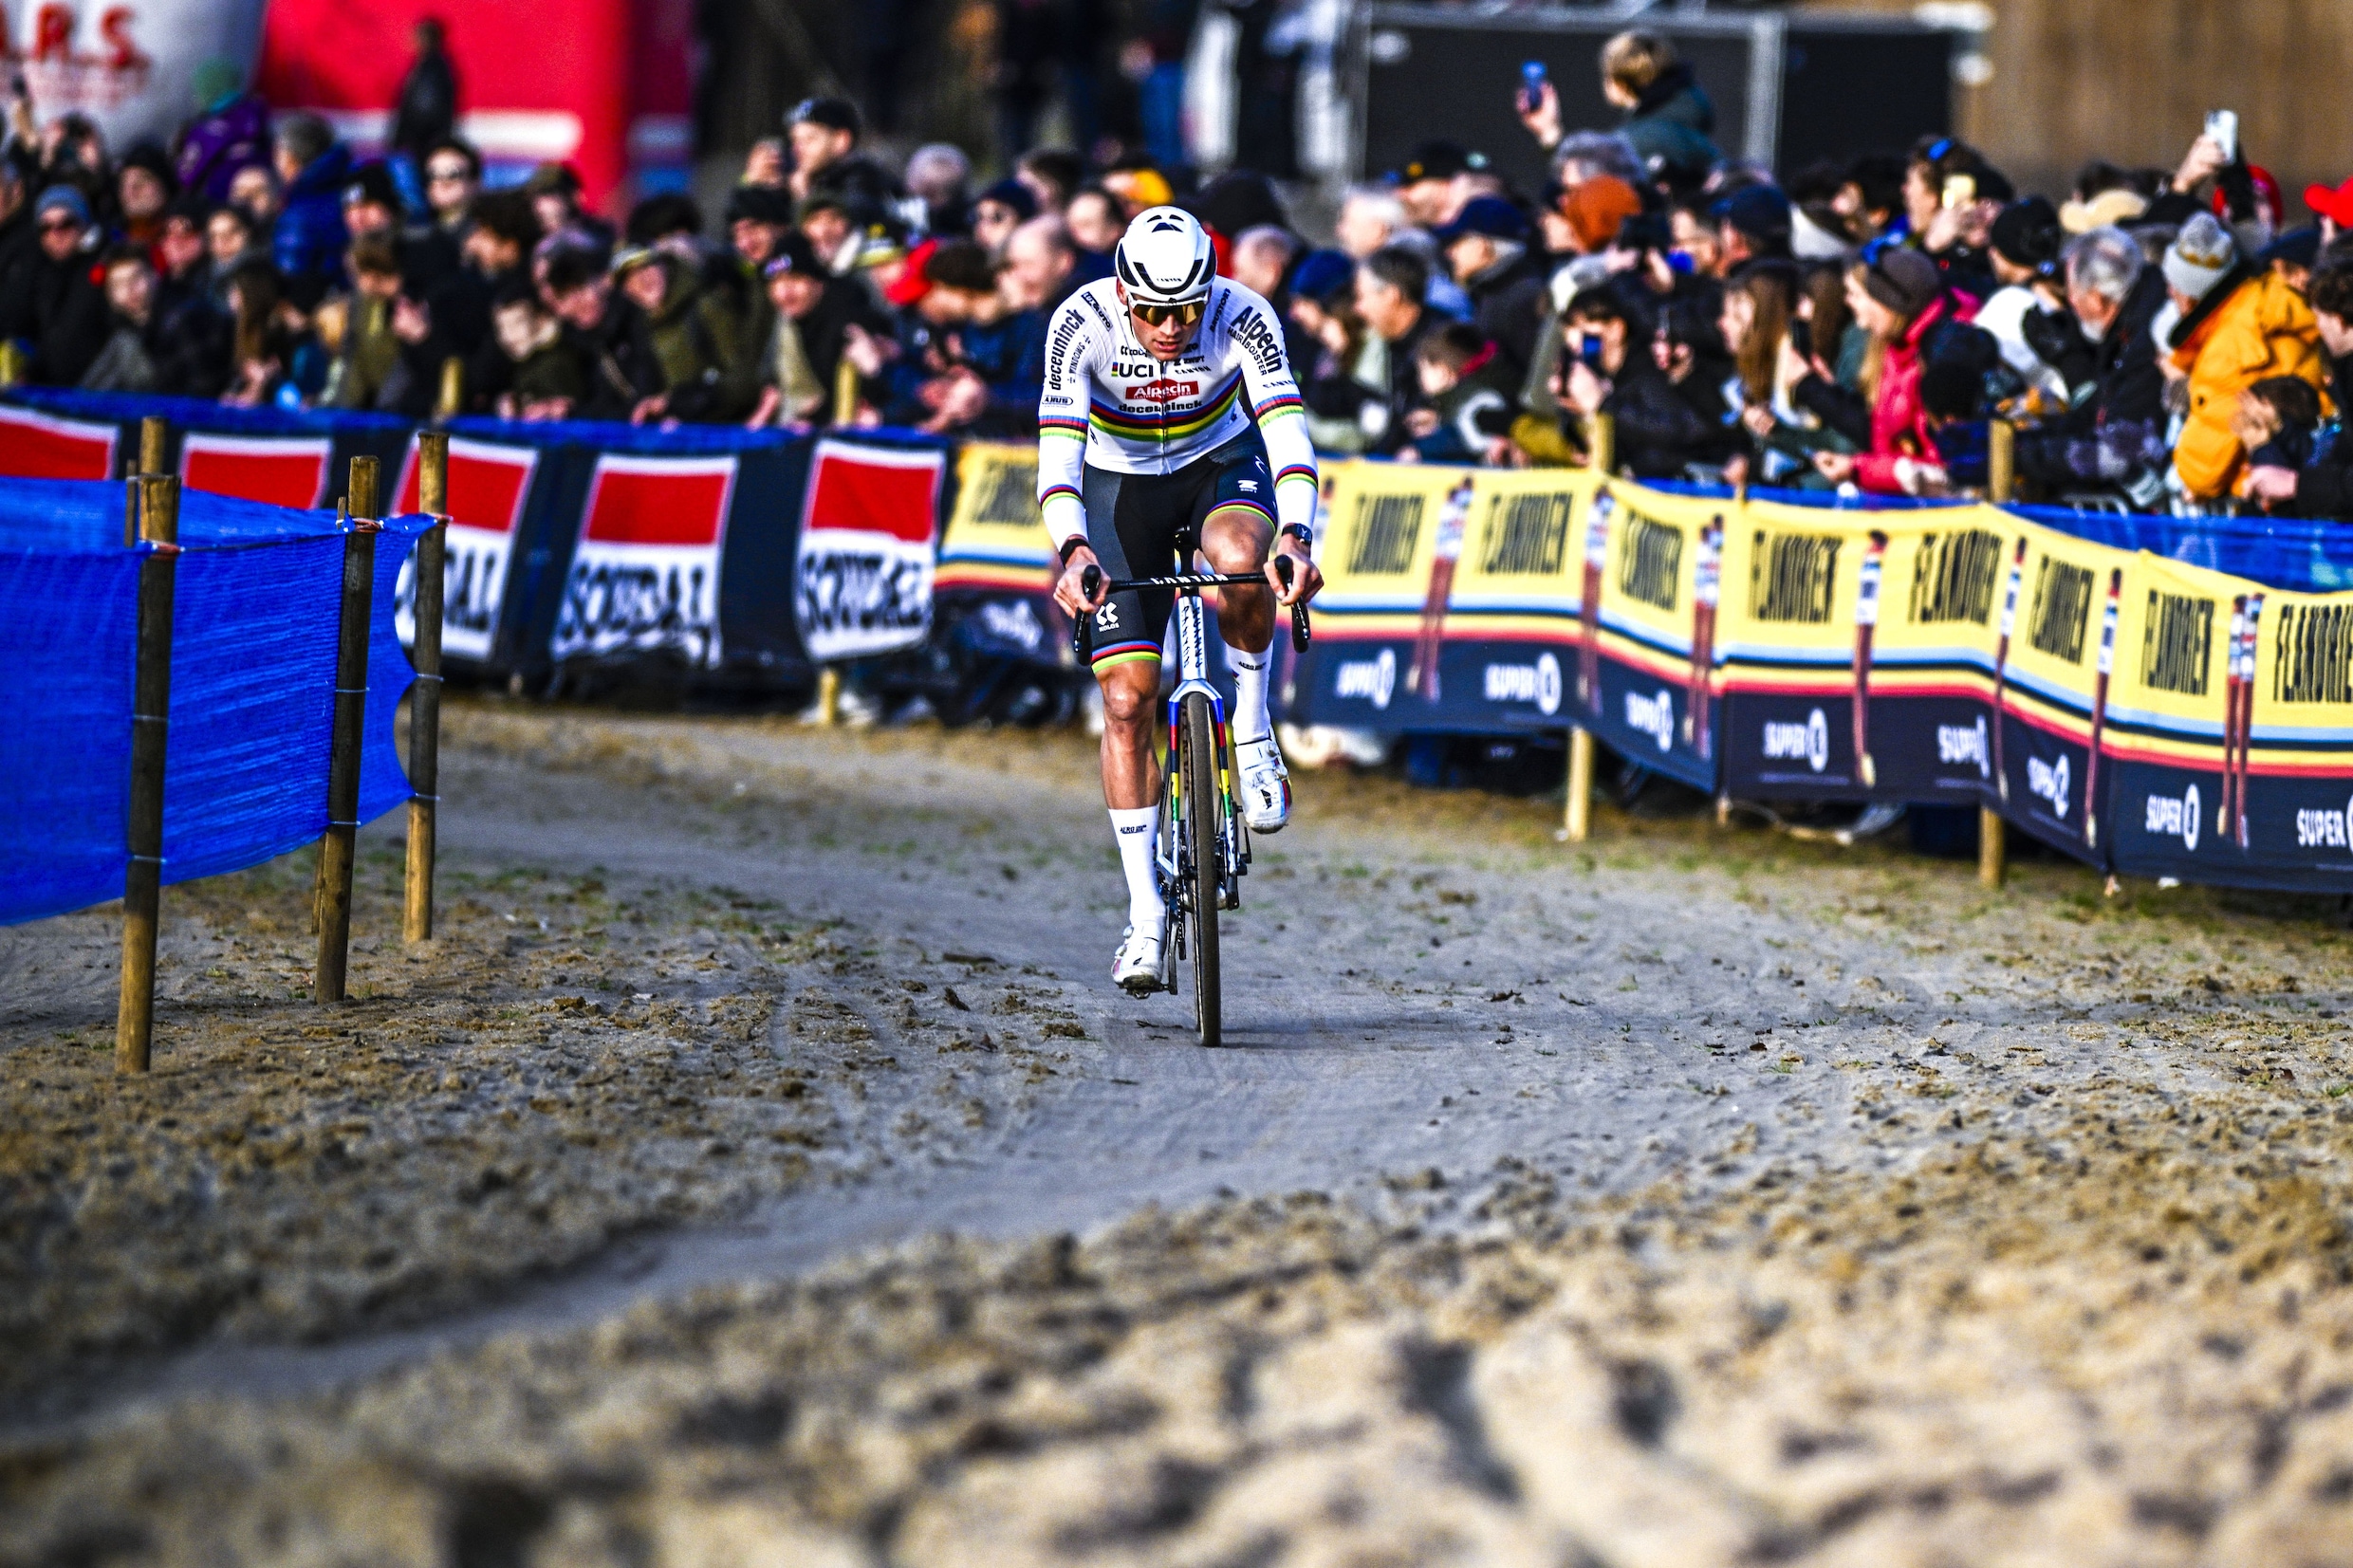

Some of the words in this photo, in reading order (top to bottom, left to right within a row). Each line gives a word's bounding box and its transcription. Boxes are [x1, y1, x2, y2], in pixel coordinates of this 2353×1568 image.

[1048, 308, 1085, 391] deceuninck
[1231, 305, 1283, 374] Alpecin
[1120, 362, 1154, 378] UCI
[1134, 381, 1191, 398] Alpecin
[1150, 573, 1230, 585] CANYON
[2296, 808, 2347, 847] SUPER
